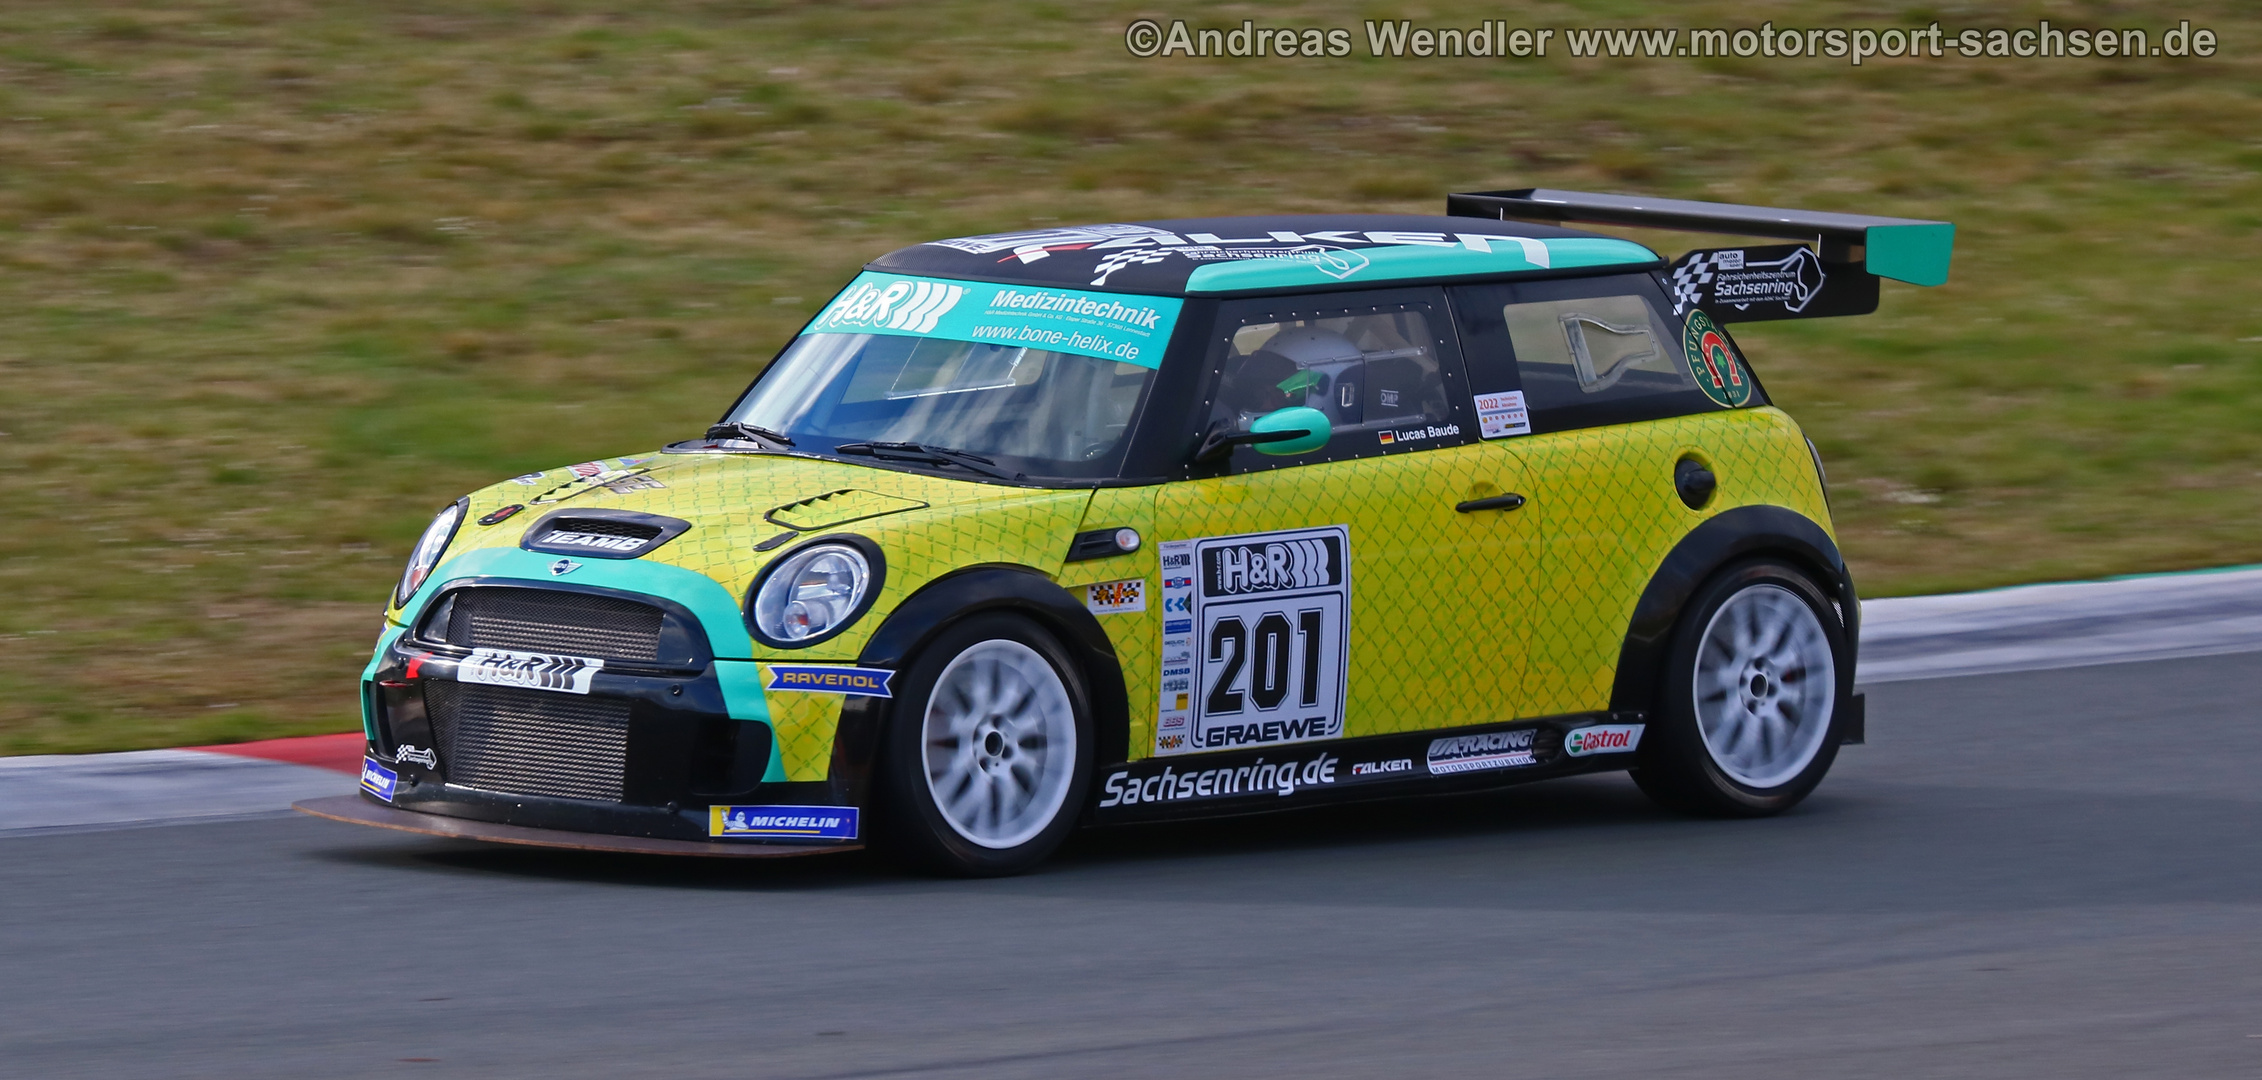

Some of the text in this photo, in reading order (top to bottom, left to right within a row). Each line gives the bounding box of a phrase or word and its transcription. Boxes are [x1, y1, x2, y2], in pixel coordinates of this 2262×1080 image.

[998, 231, 1550, 269] FALKEN
[1720, 251, 1738, 260] auto
[1717, 270, 1796, 281] Fahrsicherheitszentrum
[1714, 279, 1794, 297] Sachsenring
[815, 280, 916, 330] H&R
[989, 289, 1161, 330] Medizintechnik
[971, 324, 1140, 360] www.bone-helix.de
[1478, 398, 1499, 410] 2022
[1396, 424, 1460, 442] Lucas Baude
[1222, 546, 1295, 594] H&R
[477, 651, 542, 686] H&R
[1163, 667, 1190, 677] DMSB
[1203, 607, 1323, 717] 201
[783, 672, 879, 689] RAVENOL
[1205, 716, 1326, 747] GRAEWE
[1582, 730, 1631, 751] Castrol
[1352, 758, 1412, 775] FALKEN
[365, 769, 391, 789] MICHELIN
[1099, 752, 1338, 808] Sachsenring.de
[751, 816, 840, 829] MICHELIN
